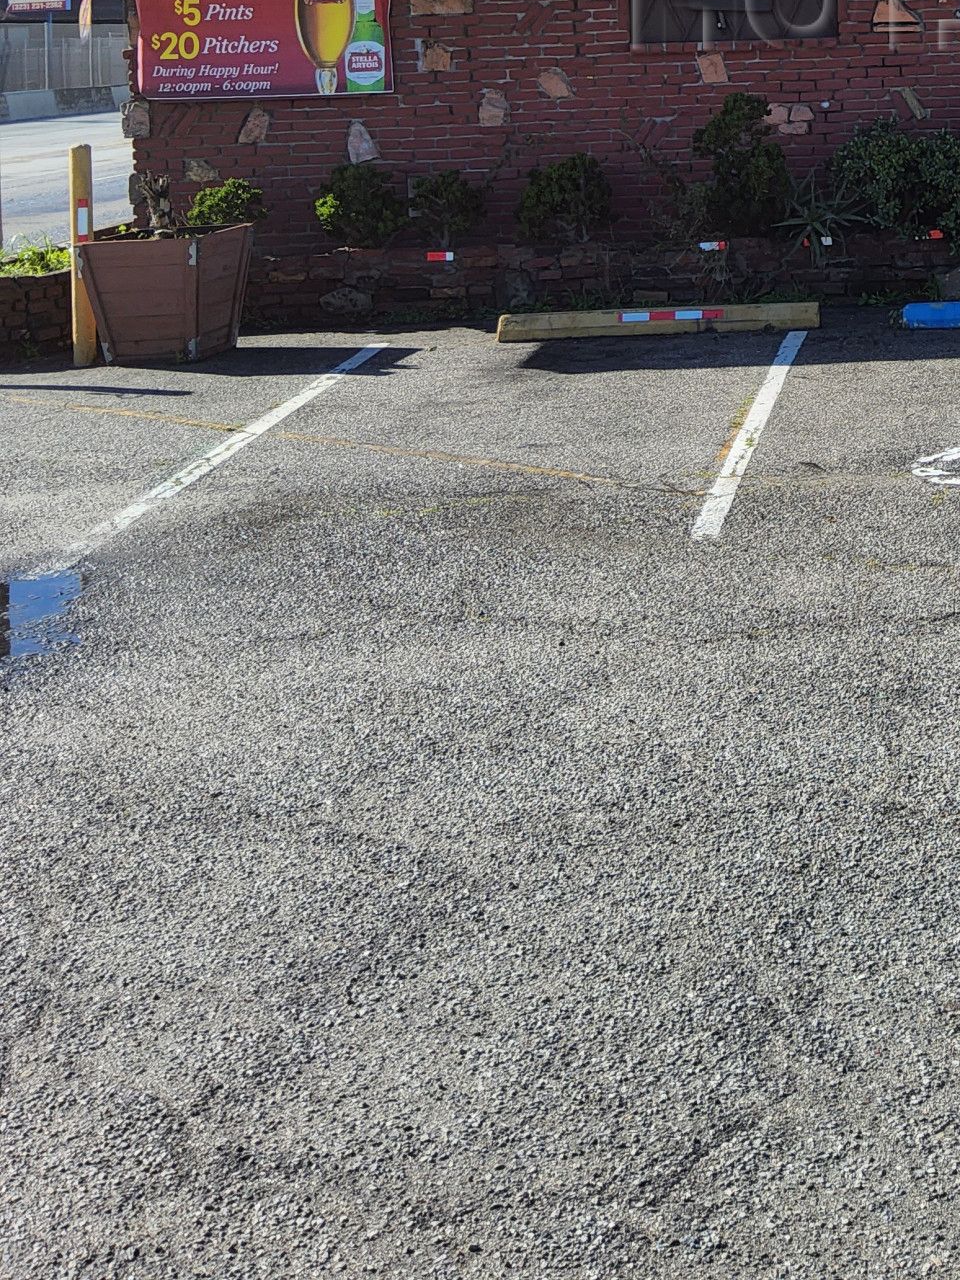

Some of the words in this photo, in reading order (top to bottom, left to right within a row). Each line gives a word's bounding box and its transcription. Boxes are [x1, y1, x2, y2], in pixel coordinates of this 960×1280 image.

[204, 3, 254, 21] Pints
[151, 31, 200, 60] $20
[202, 35, 280, 54] Pitchers
[152, 65, 196, 79] During
[198, 64, 241, 79] Happy
[242, 63, 279, 75] Hour!
[158, 82, 212, 95] 12:00pm
[222, 80, 271, 92] 6:00pm
